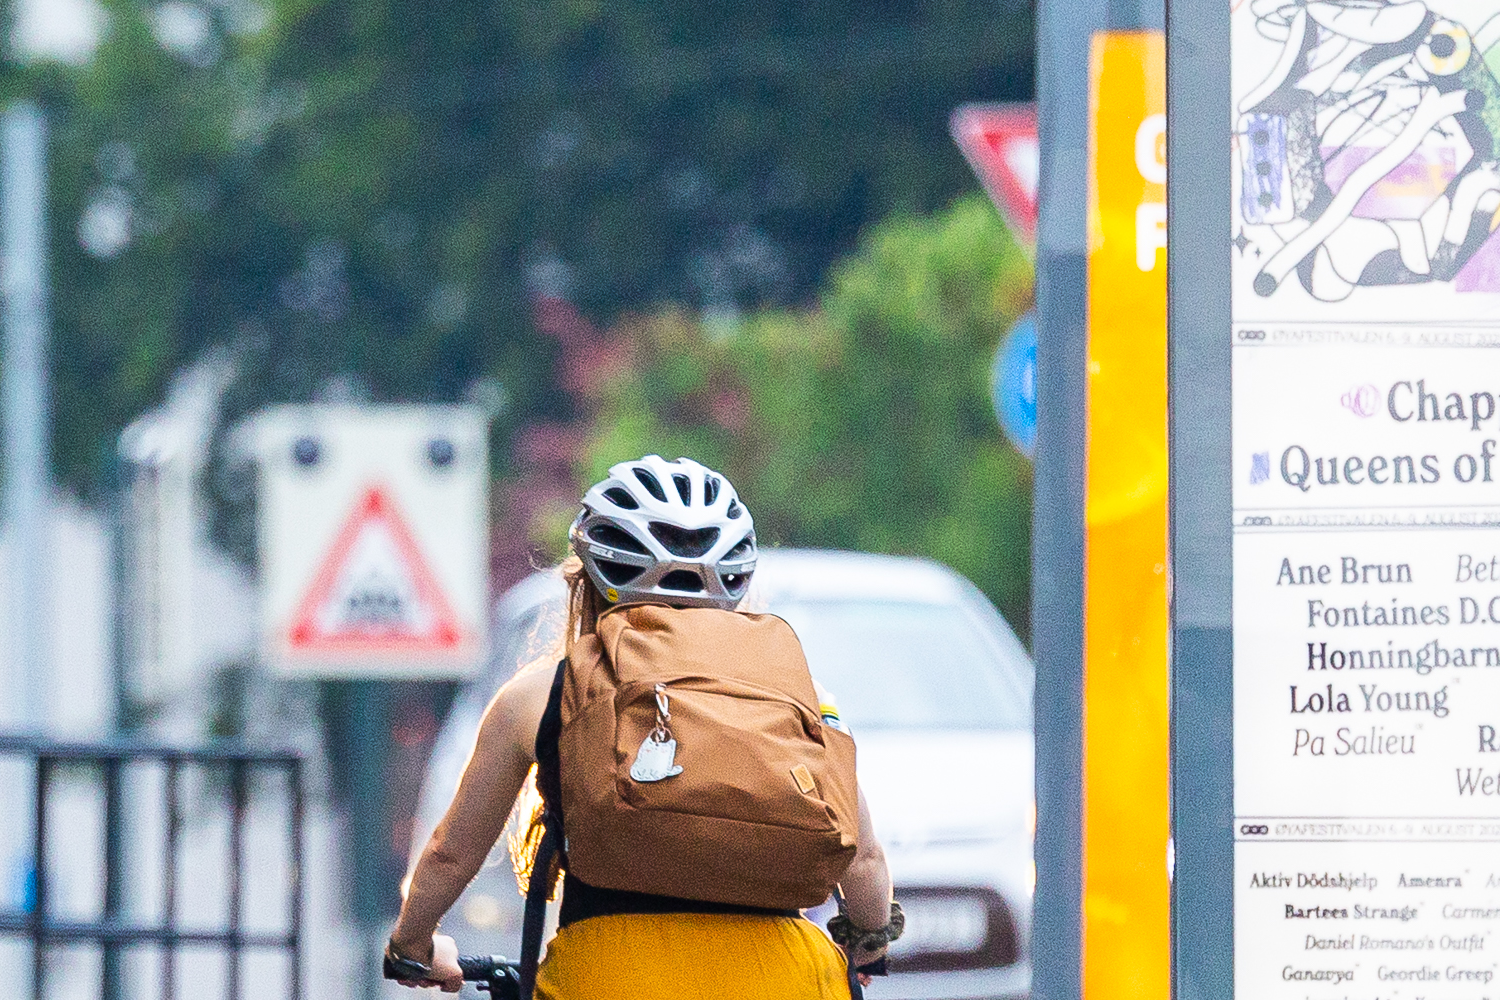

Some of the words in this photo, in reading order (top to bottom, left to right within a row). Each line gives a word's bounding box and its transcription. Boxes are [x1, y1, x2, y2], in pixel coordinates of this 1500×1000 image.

[1386, 378, 1500, 432] Chap
[1279, 444, 1442, 494] Queens
[1452, 438, 1499, 484] of
[1275, 556, 1332, 586] Ane
[1340, 555, 1413, 585] Brun
[1307, 597, 1451, 629] Fontaines
[1289, 683, 1353, 714] Lola
[1358, 683, 1451, 719] Young
[1292, 728, 1326, 757] Pa
[1333, 725, 1416, 757] Salieu
[1477, 724, 1500, 753] R
[1249, 871, 1293, 889] Aktiv
[1397, 872, 1463, 889] Amenra
[1284, 903, 1349, 920] Bartees
[1353, 903, 1419, 923] Strange
[1304, 933, 1355, 951] Daniel
[1358, 933, 1435, 951] Romano's
[1438, 933, 1485, 954] Outfit
[1376, 964, 1441, 982] Geordie
[1444, 963, 1495, 986] Greep
